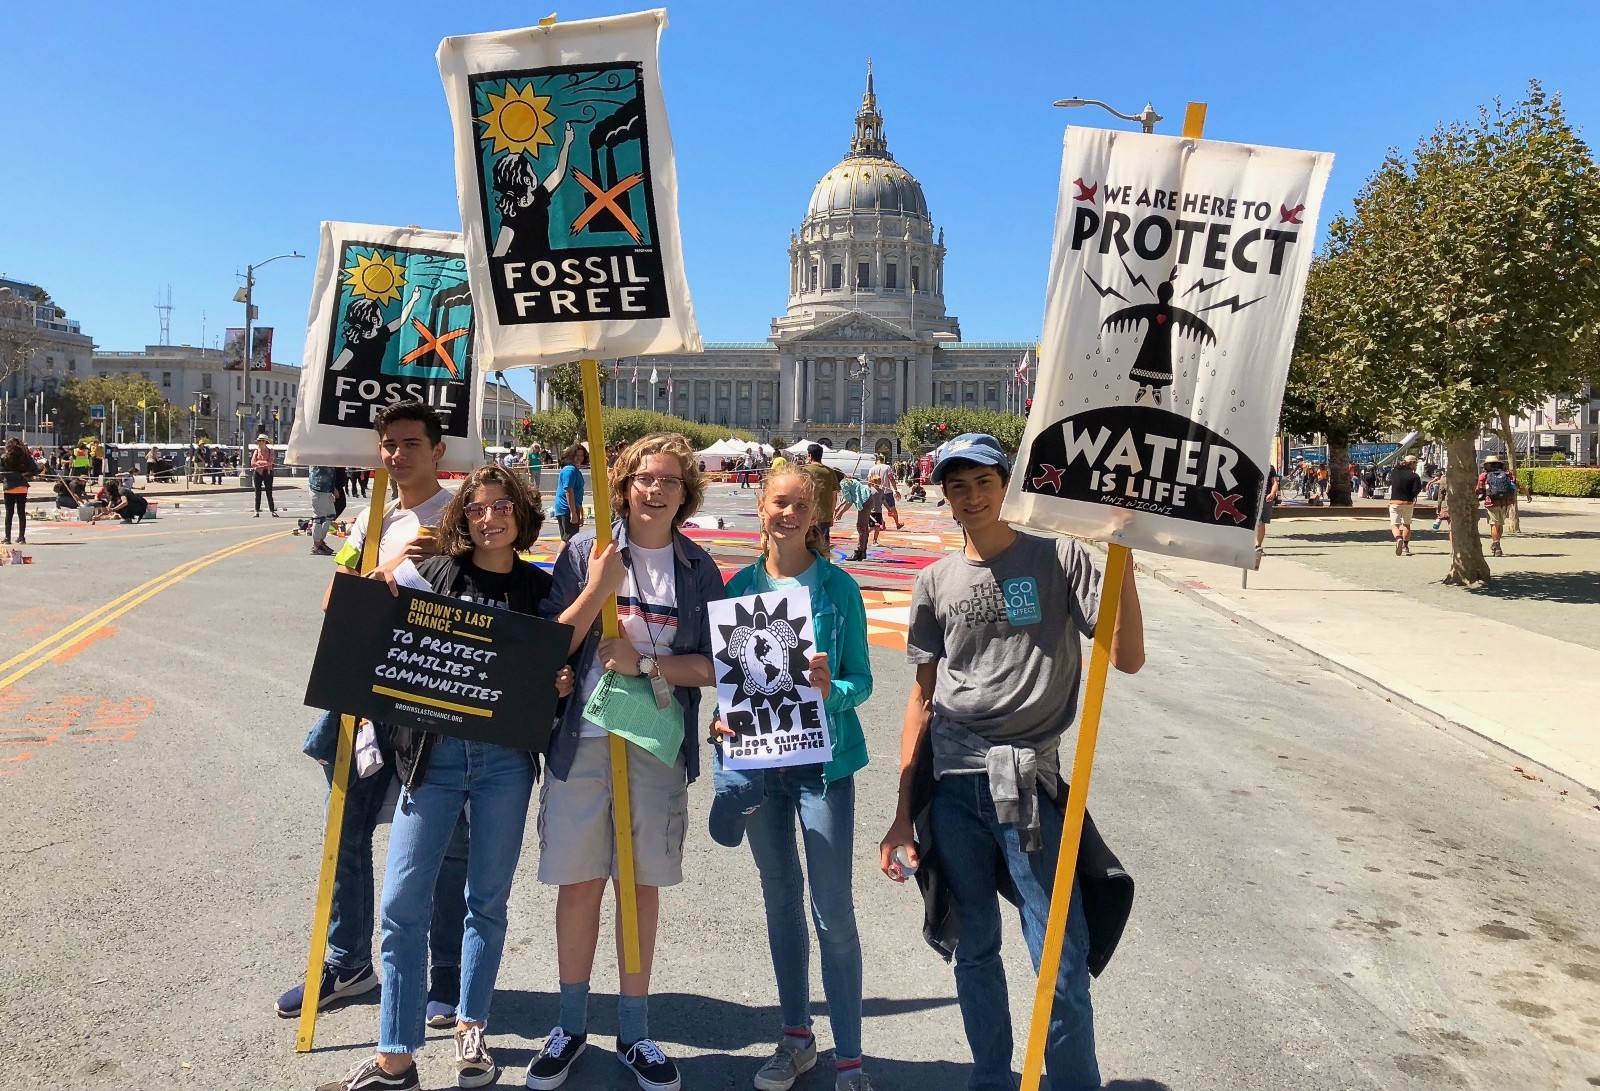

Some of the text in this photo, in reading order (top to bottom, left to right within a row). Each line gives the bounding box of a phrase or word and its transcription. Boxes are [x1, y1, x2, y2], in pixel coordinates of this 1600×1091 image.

[1104, 185, 1272, 221] WE ARE HERE TO
[1071, 207, 1298, 275] PROTECT
[503, 256, 650, 288] FOSSIL
[513, 286, 647, 317] FREE
[335, 376, 457, 408] FOSSIL
[1062, 420, 1239, 491] WATER
[1090, 470, 1187, 506] IS LIFE
[1101, 495, 1172, 515] MNI WICONI
[970, 581, 1002, 597] THE
[410, 598, 462, 621] BROWN'S
[465, 611, 494, 629] LAST
[949, 595, 1006, 617] NORTH
[965, 608, 1008, 628] FACE
[1012, 606, 1036, 616] EFFECT
[407, 611, 453, 633] CHANCE
[393, 628, 498, 664] TO PROTECT
[387, 647, 475, 678] FAMILIES
[375, 664, 503, 702] COMMUNITIES
[727, 701, 822, 748] RISE
[745, 731, 824, 748] FOR CLIMATE
[730, 740, 825, 759] JOBS & JUSTICE
